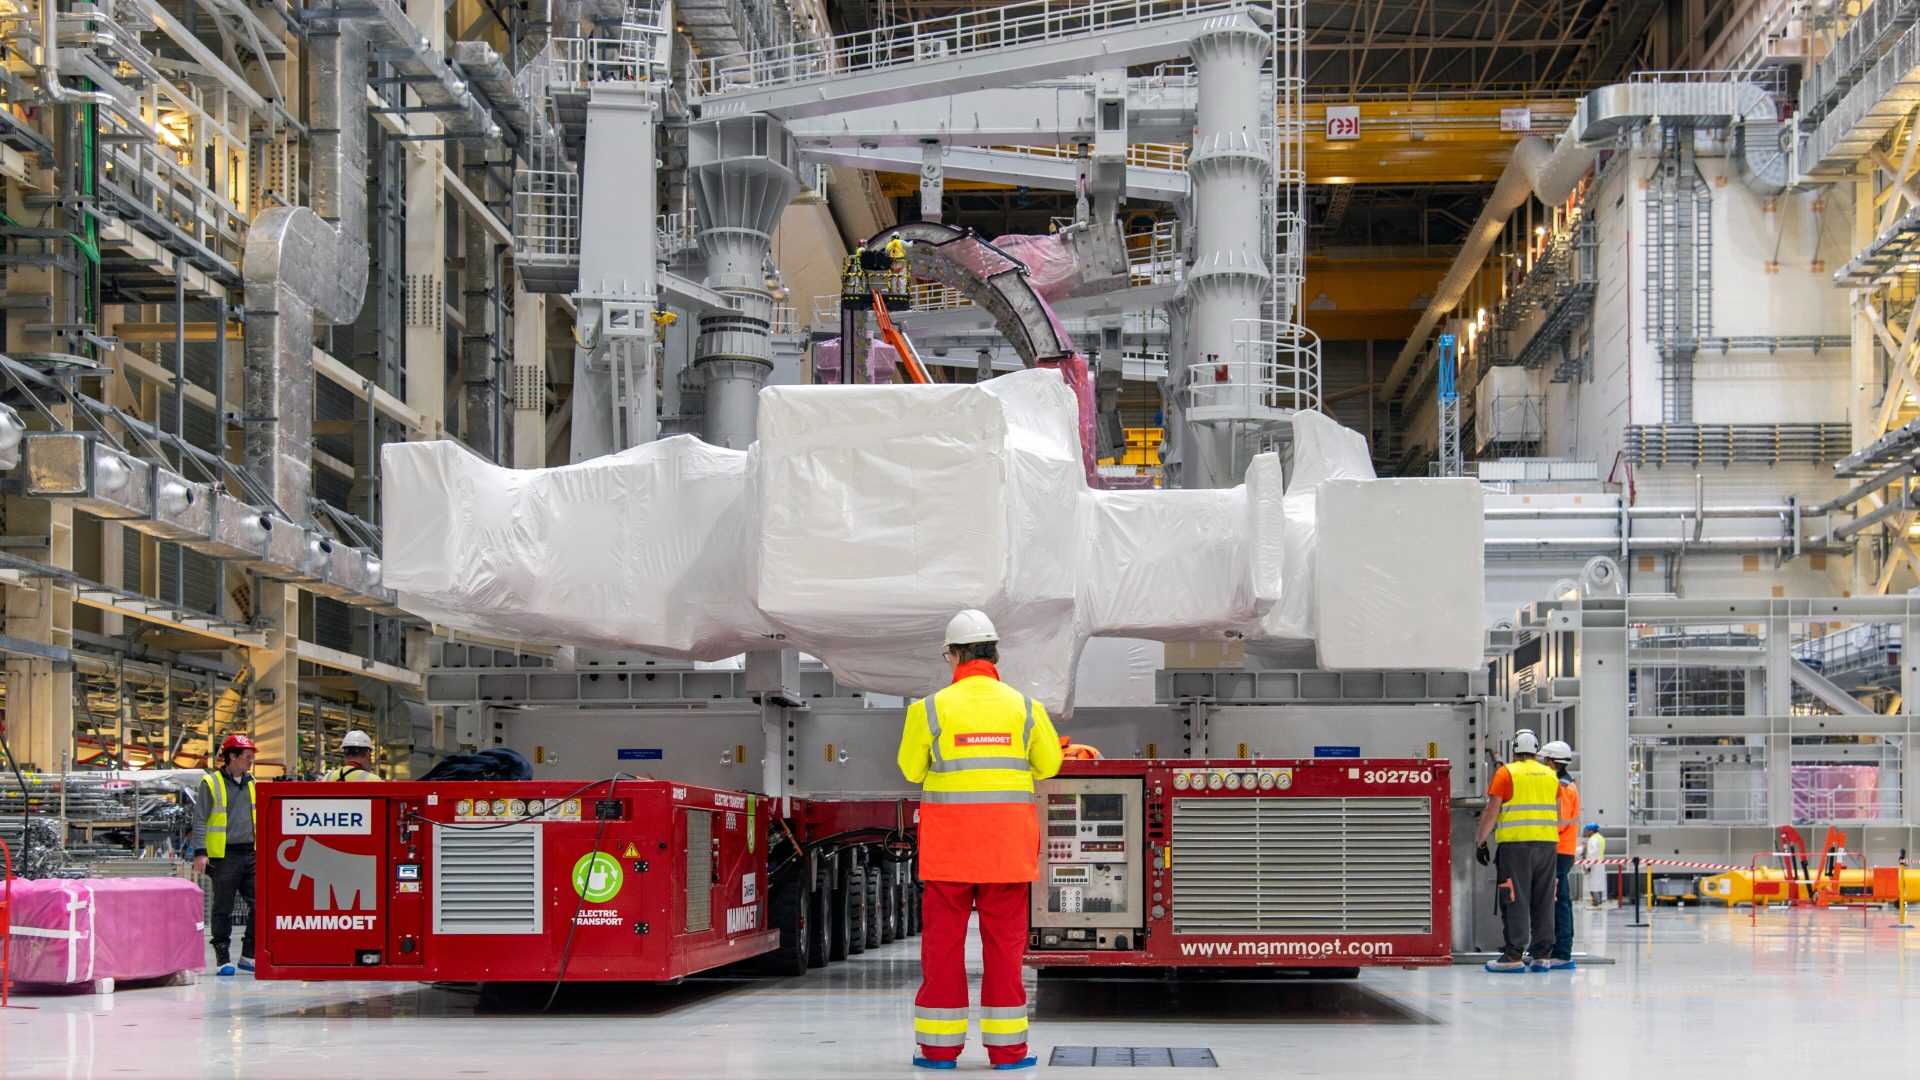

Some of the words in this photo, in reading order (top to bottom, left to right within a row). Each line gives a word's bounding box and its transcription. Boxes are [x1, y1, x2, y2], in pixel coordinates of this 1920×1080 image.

[1364, 770, 1432, 784] 302750
[296, 812, 363, 827] DAHER
[577, 909, 618, 918] ELECTRIC
[276, 915, 377, 930] MAMMOET
[571, 917, 623, 926] TRANSPORT
[1180, 938, 1394, 956] www.mammoet.com
